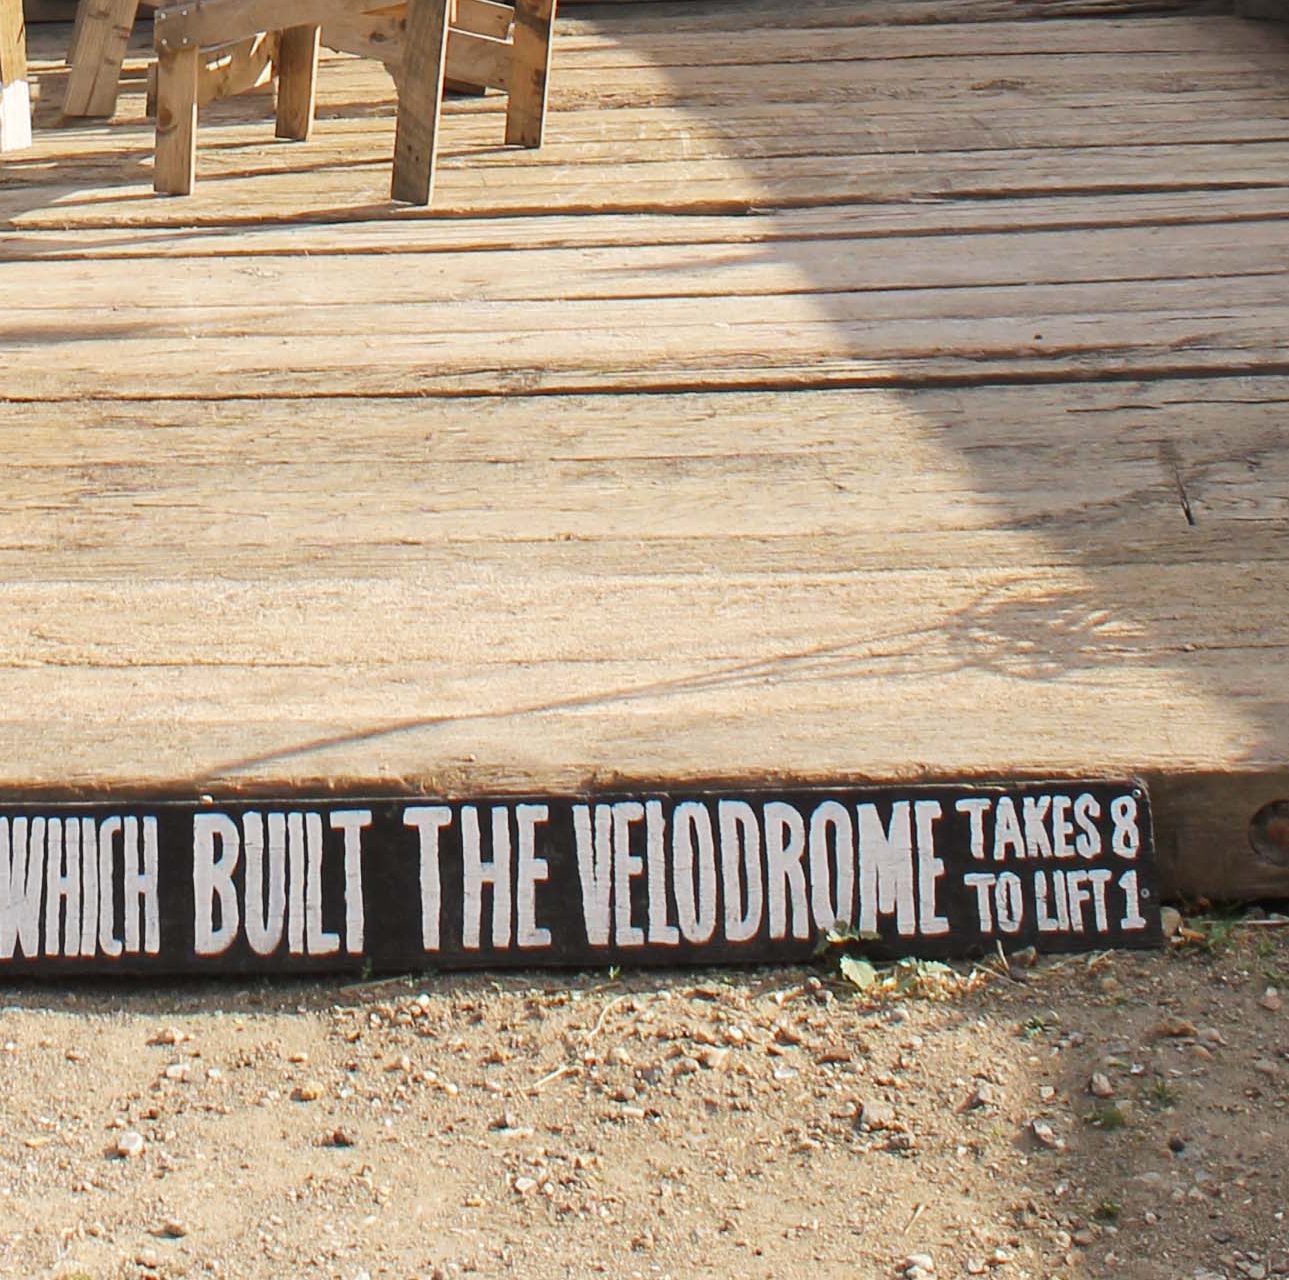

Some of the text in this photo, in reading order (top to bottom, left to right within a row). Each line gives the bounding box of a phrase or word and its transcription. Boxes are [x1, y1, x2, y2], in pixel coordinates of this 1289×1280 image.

[955, 793, 1141, 861] TAKES 8
[193, 809, 372, 956] BUILT
[403, 803, 552, 952] THE
[572, 797, 949, 948] VELODROME
[962, 868, 1147, 936] TO LIFT 1
